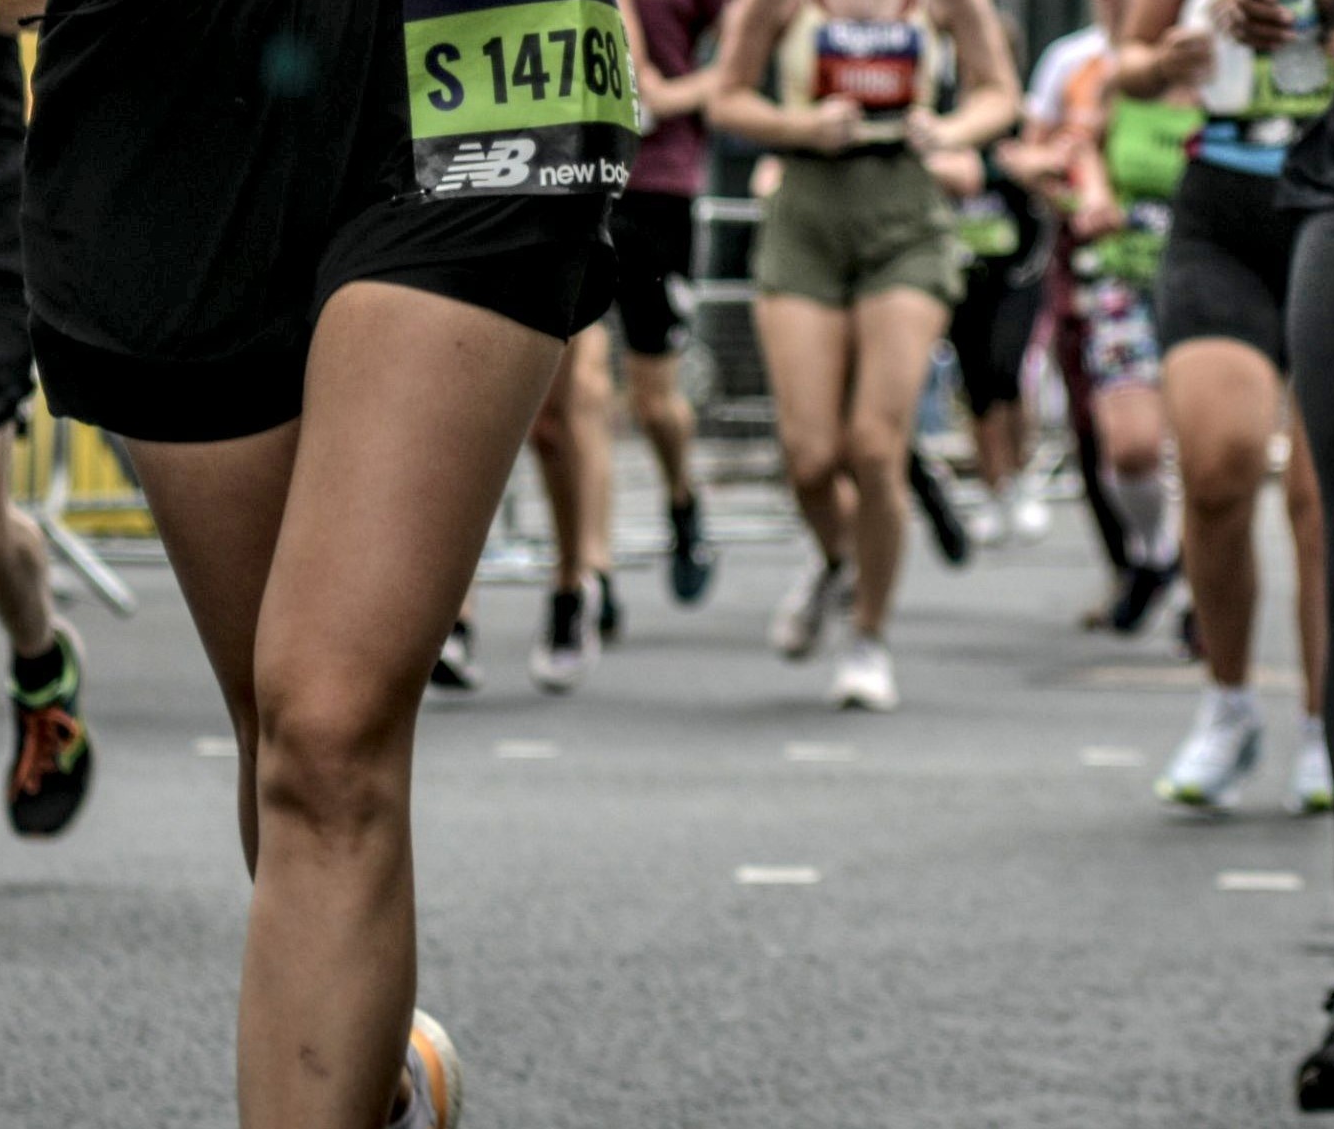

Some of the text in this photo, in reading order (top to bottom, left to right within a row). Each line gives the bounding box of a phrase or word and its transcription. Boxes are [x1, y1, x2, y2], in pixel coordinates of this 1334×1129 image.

[425, 42, 465, 112] S
[482, 26, 623, 105] 14768
[540, 163, 596, 187] new
